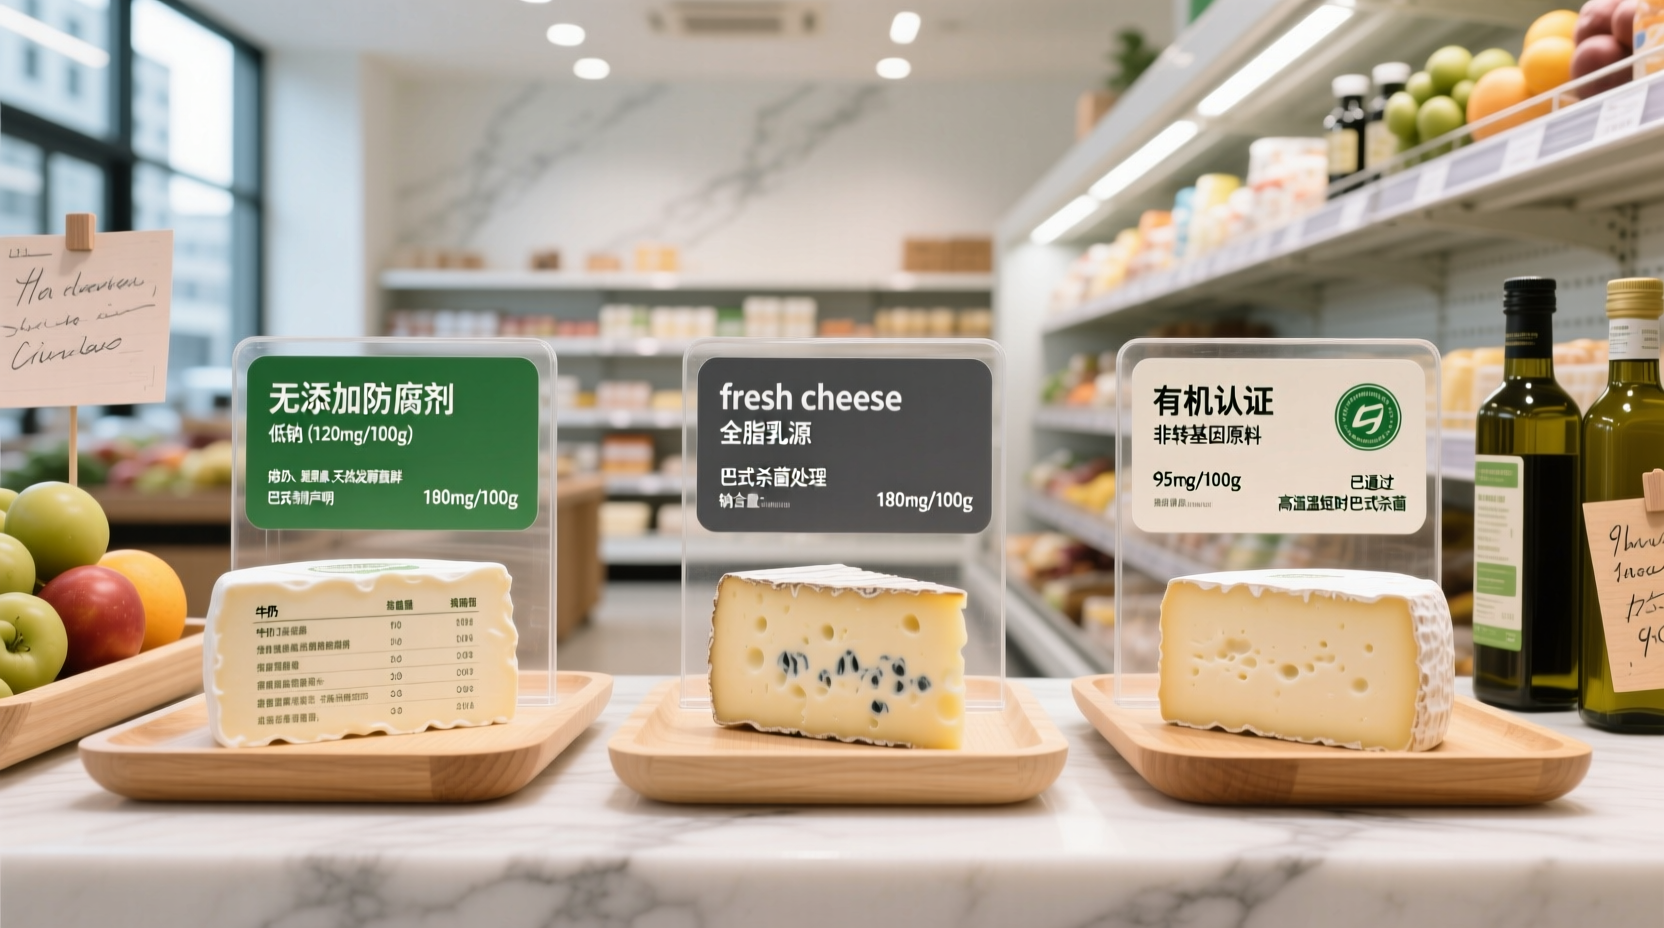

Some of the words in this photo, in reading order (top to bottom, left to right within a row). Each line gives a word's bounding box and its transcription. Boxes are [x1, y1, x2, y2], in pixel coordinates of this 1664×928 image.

[269, 381, 454, 416] 无添加防腐剂
[720, 382, 793, 411] fresh
[801, 382, 903, 412] cheese
[1153, 384, 1274, 417] 有机认证
[308, 424, 414, 447] (120mg/100g)
[719, 420, 812, 446] 全脂乳源
[1153, 424, 1262, 446] 非转基因原料
[721, 467, 826, 488] 巴式杀菌处理
[1153, 471, 1242, 491] 95mg/100g
[424, 489, 519, 511] 180mg/100g
[877, 491, 974, 514] 180mg/100g
